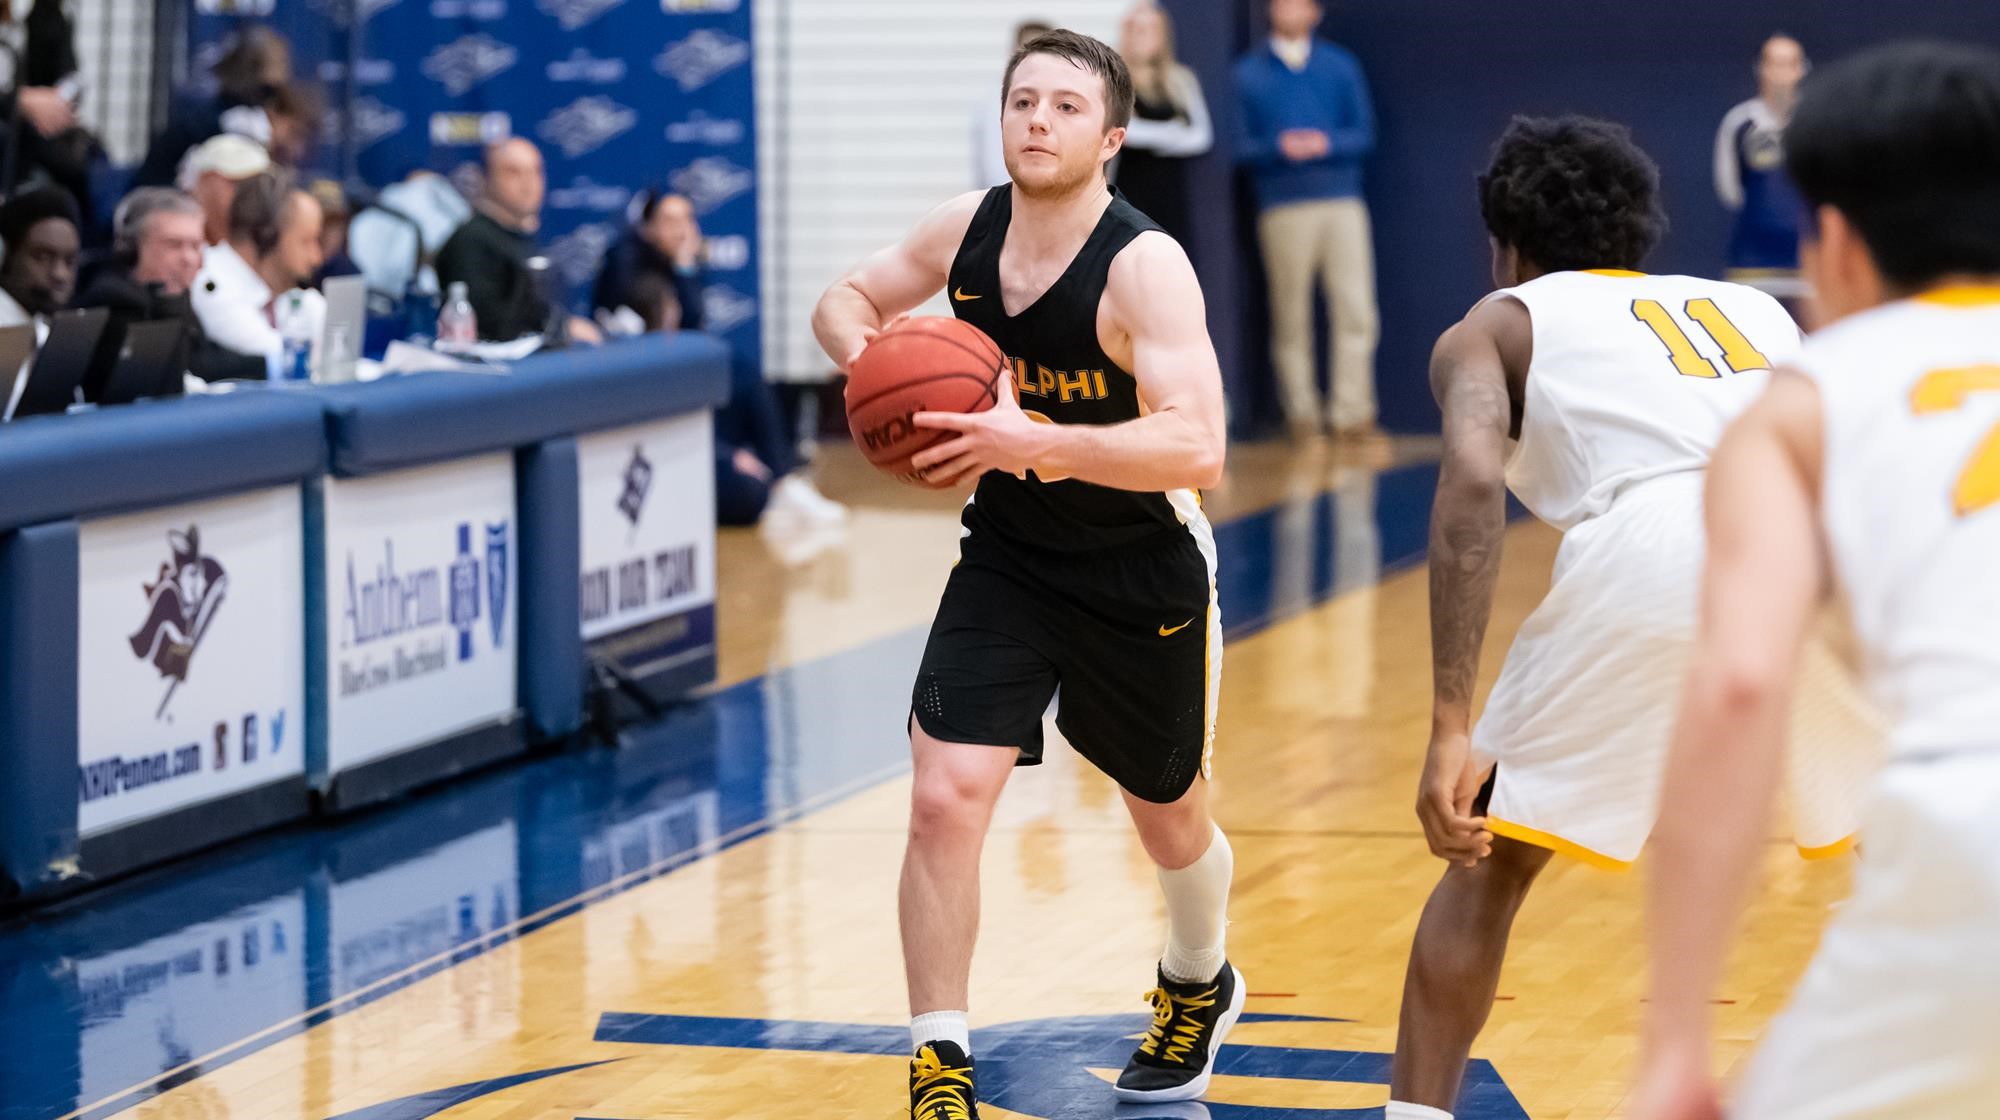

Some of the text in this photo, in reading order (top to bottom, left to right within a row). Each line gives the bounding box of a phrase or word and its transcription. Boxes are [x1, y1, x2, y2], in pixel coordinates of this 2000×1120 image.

[1630, 298, 1775, 379] 11
[1008, 356, 1109, 403] LPHI
[341, 537, 442, 649] Anthem
